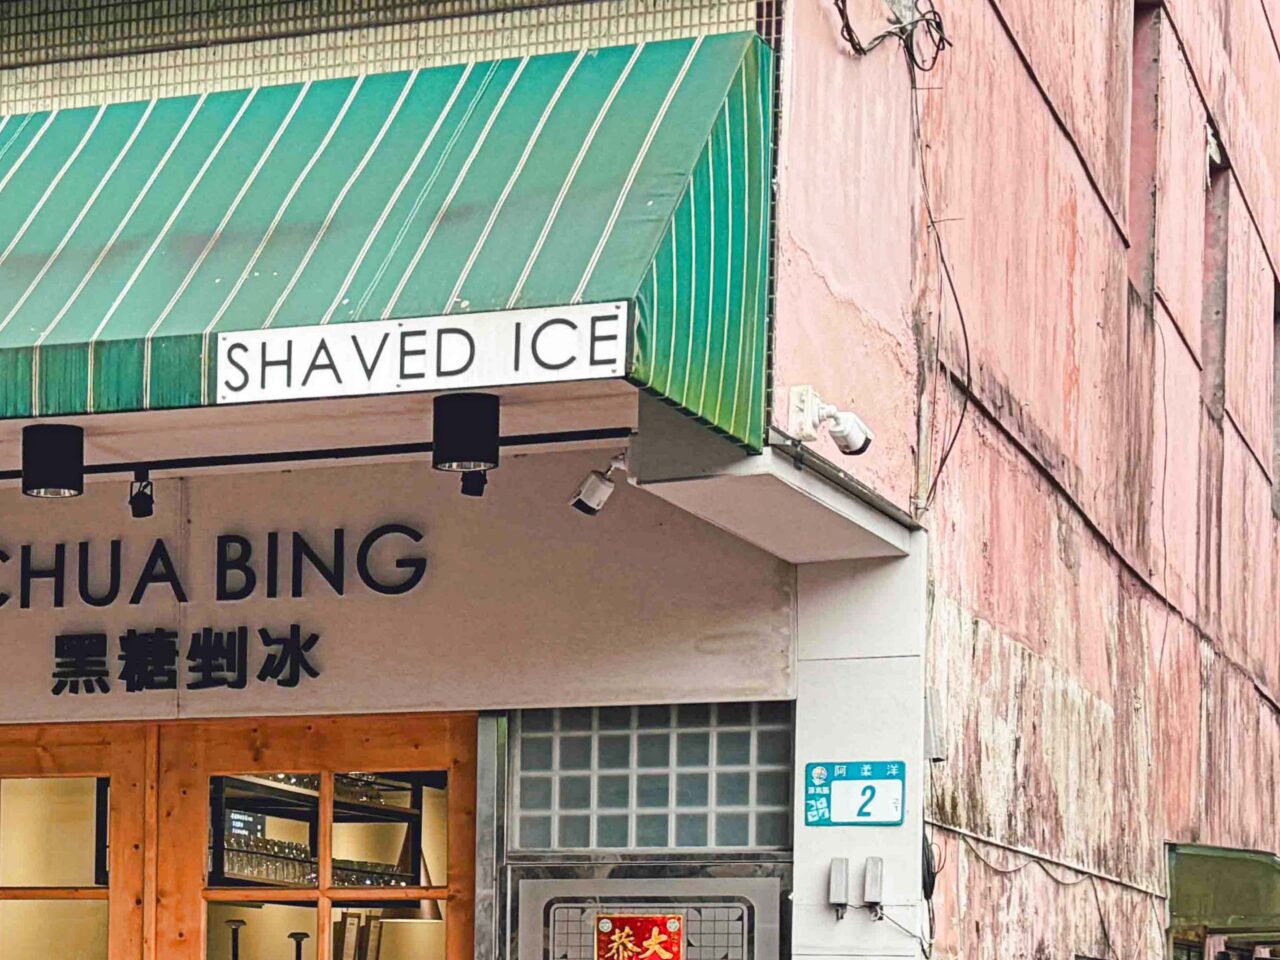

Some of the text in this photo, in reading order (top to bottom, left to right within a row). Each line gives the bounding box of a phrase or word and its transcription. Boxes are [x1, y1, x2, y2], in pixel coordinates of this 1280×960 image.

[224, 314, 619, 392] SHAVED ICE
[216, 524, 427, 602] BING
[834, 764, 899, 777] 阿柔洋
[856, 785, 876, 817] 2
